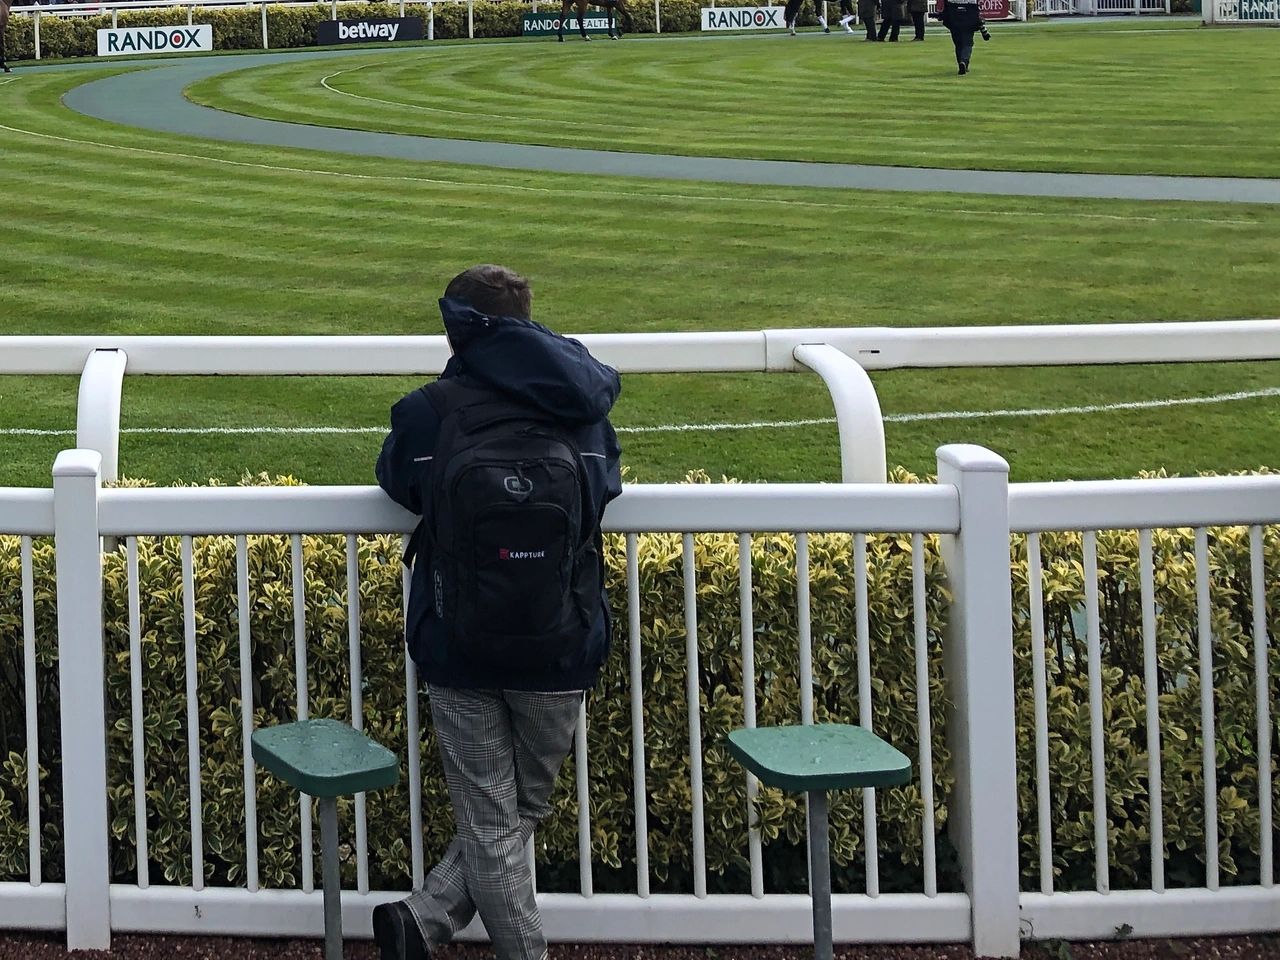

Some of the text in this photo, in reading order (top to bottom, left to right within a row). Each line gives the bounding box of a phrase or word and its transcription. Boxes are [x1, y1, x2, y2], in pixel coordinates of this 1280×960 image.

[708, 8, 779, 28] RANDOX
[107, 28, 202, 53] RANDOX
[337, 20, 400, 41] betway
[509, 549, 546, 559] KAPPTURE
